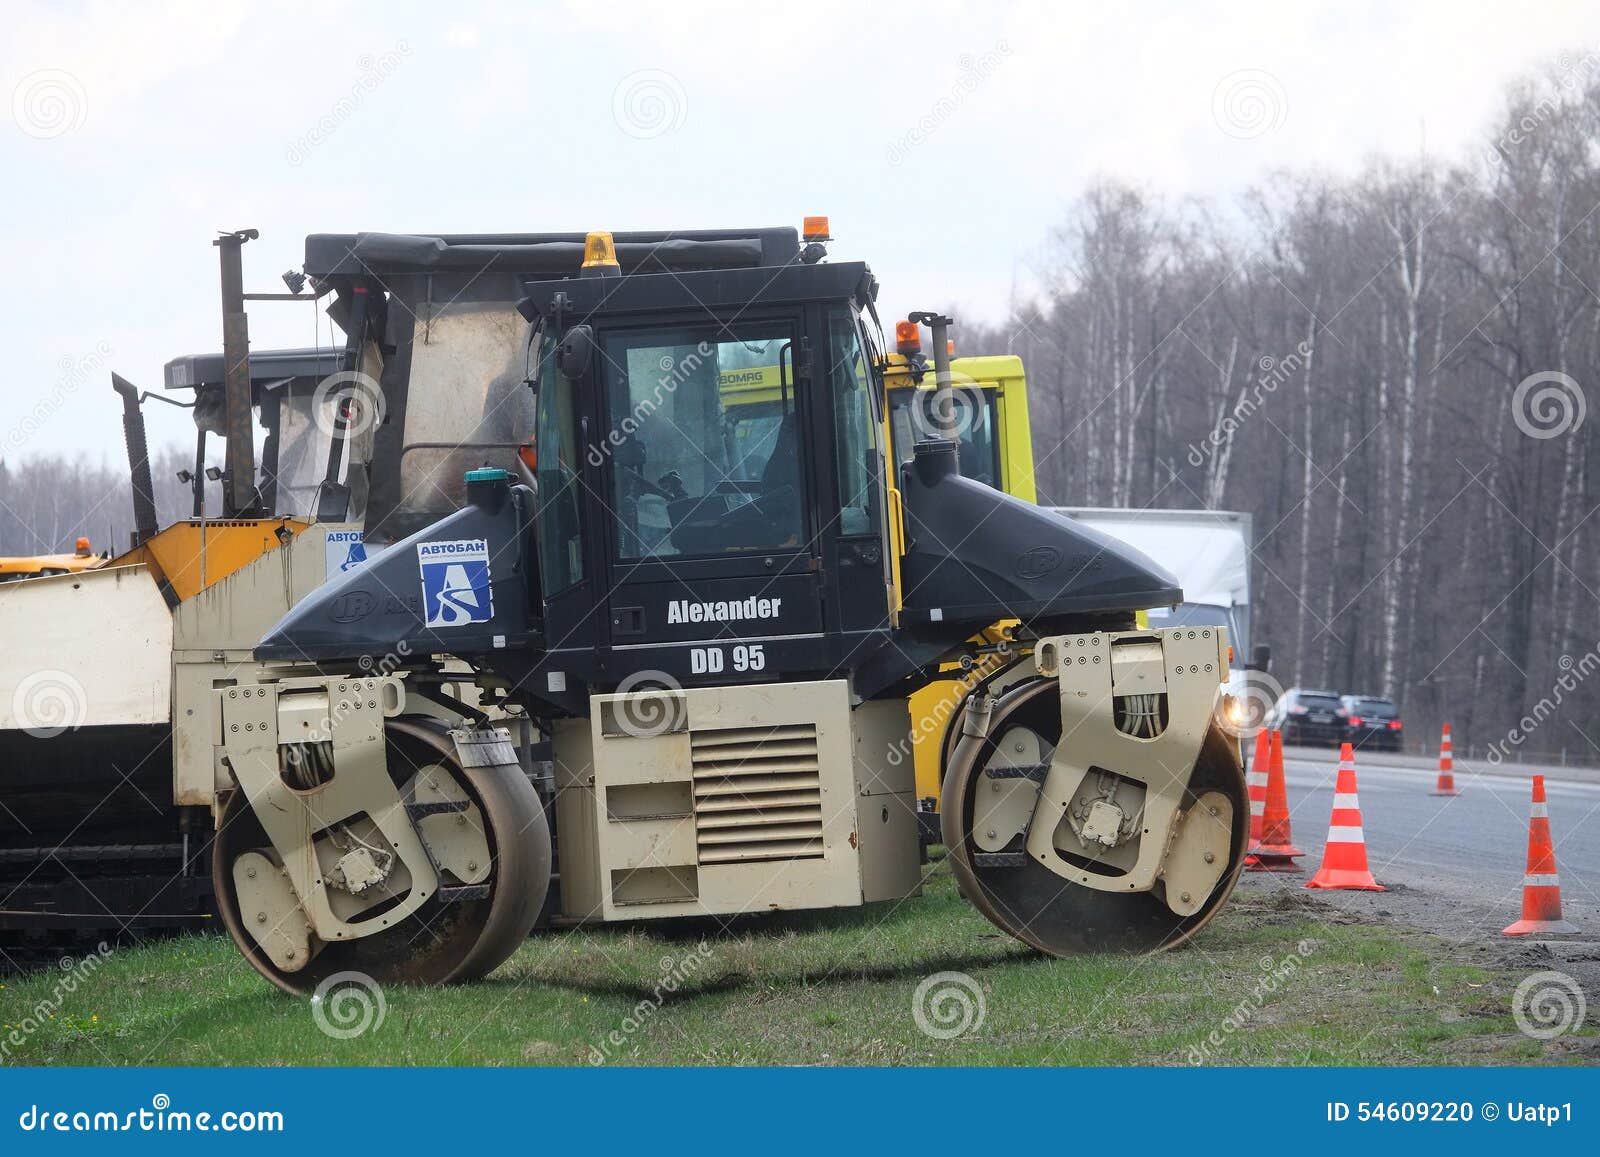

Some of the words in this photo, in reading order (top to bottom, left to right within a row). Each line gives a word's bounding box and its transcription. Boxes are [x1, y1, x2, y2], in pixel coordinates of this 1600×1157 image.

[719, 371, 764, 385] BOMAG
[327, 532, 366, 542] АВТОБ
[420, 542, 486, 555] АВТОБАН
[667, 595, 782, 624] Alexander
[690, 647, 724, 674] DD
[732, 644, 766, 672] 95
